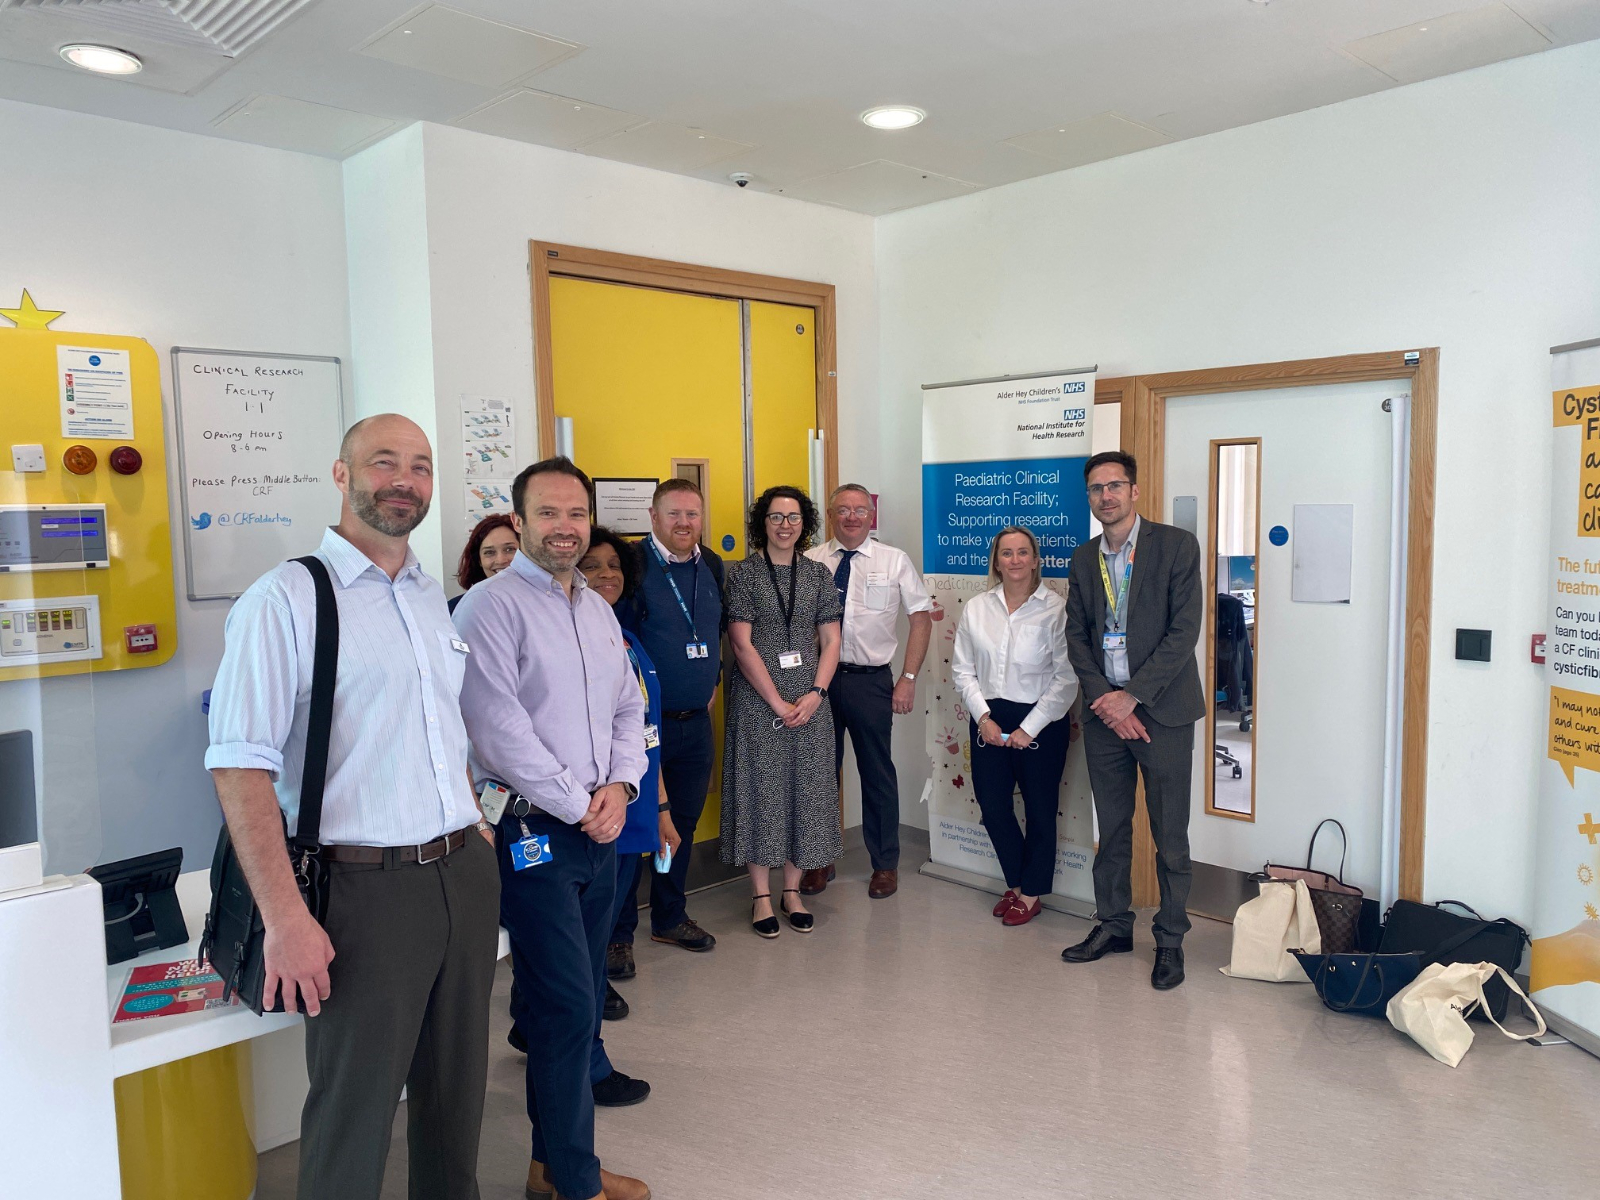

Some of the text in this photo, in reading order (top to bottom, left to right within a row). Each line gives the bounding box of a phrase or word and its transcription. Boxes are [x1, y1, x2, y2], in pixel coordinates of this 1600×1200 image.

[193, 364, 304, 376] CLINICAL RESEARCH
[1064, 382, 1085, 394] NHS
[997, 392, 1014, 400] Alder
[1064, 409, 1085, 420] NHS
[1017, 420, 1086, 432] National Institute for
[250, 430, 283, 440] Hours
[1032, 430, 1084, 440] Health Research
[263, 474, 291, 484] Middle
[955, 470, 1060, 486] Paediatric Clinical
[252, 486, 274, 496] CRF
[956, 491, 1059, 508] Research Facility;
[948, 512, 1068, 528] Supporting research
[938, 533, 950, 546] to
[952, 532, 982, 546] make
[1034, 533, 1080, 548] atients.
[946, 552, 988, 567] and the
[1040, 554, 1072, 568] etter
[1558, 556, 1580, 573] The
[1557, 578, 1600, 596] treatm
[1556, 606, 1596, 624] Can you
[1555, 624, 1578, 638] team
[1554, 644, 1560, 653] a
[1562, 642, 1576, 655] CF
[1562, 701, 1583, 718] may
[1554, 716, 1600, 735] and cure
[1554, 734, 1582, 750] others
[948, 833, 978, 846] partnership
[960, 844, 986, 857] Research
[1061, 850, 1087, 862] working
[1063, 860, 1084, 870] Health
